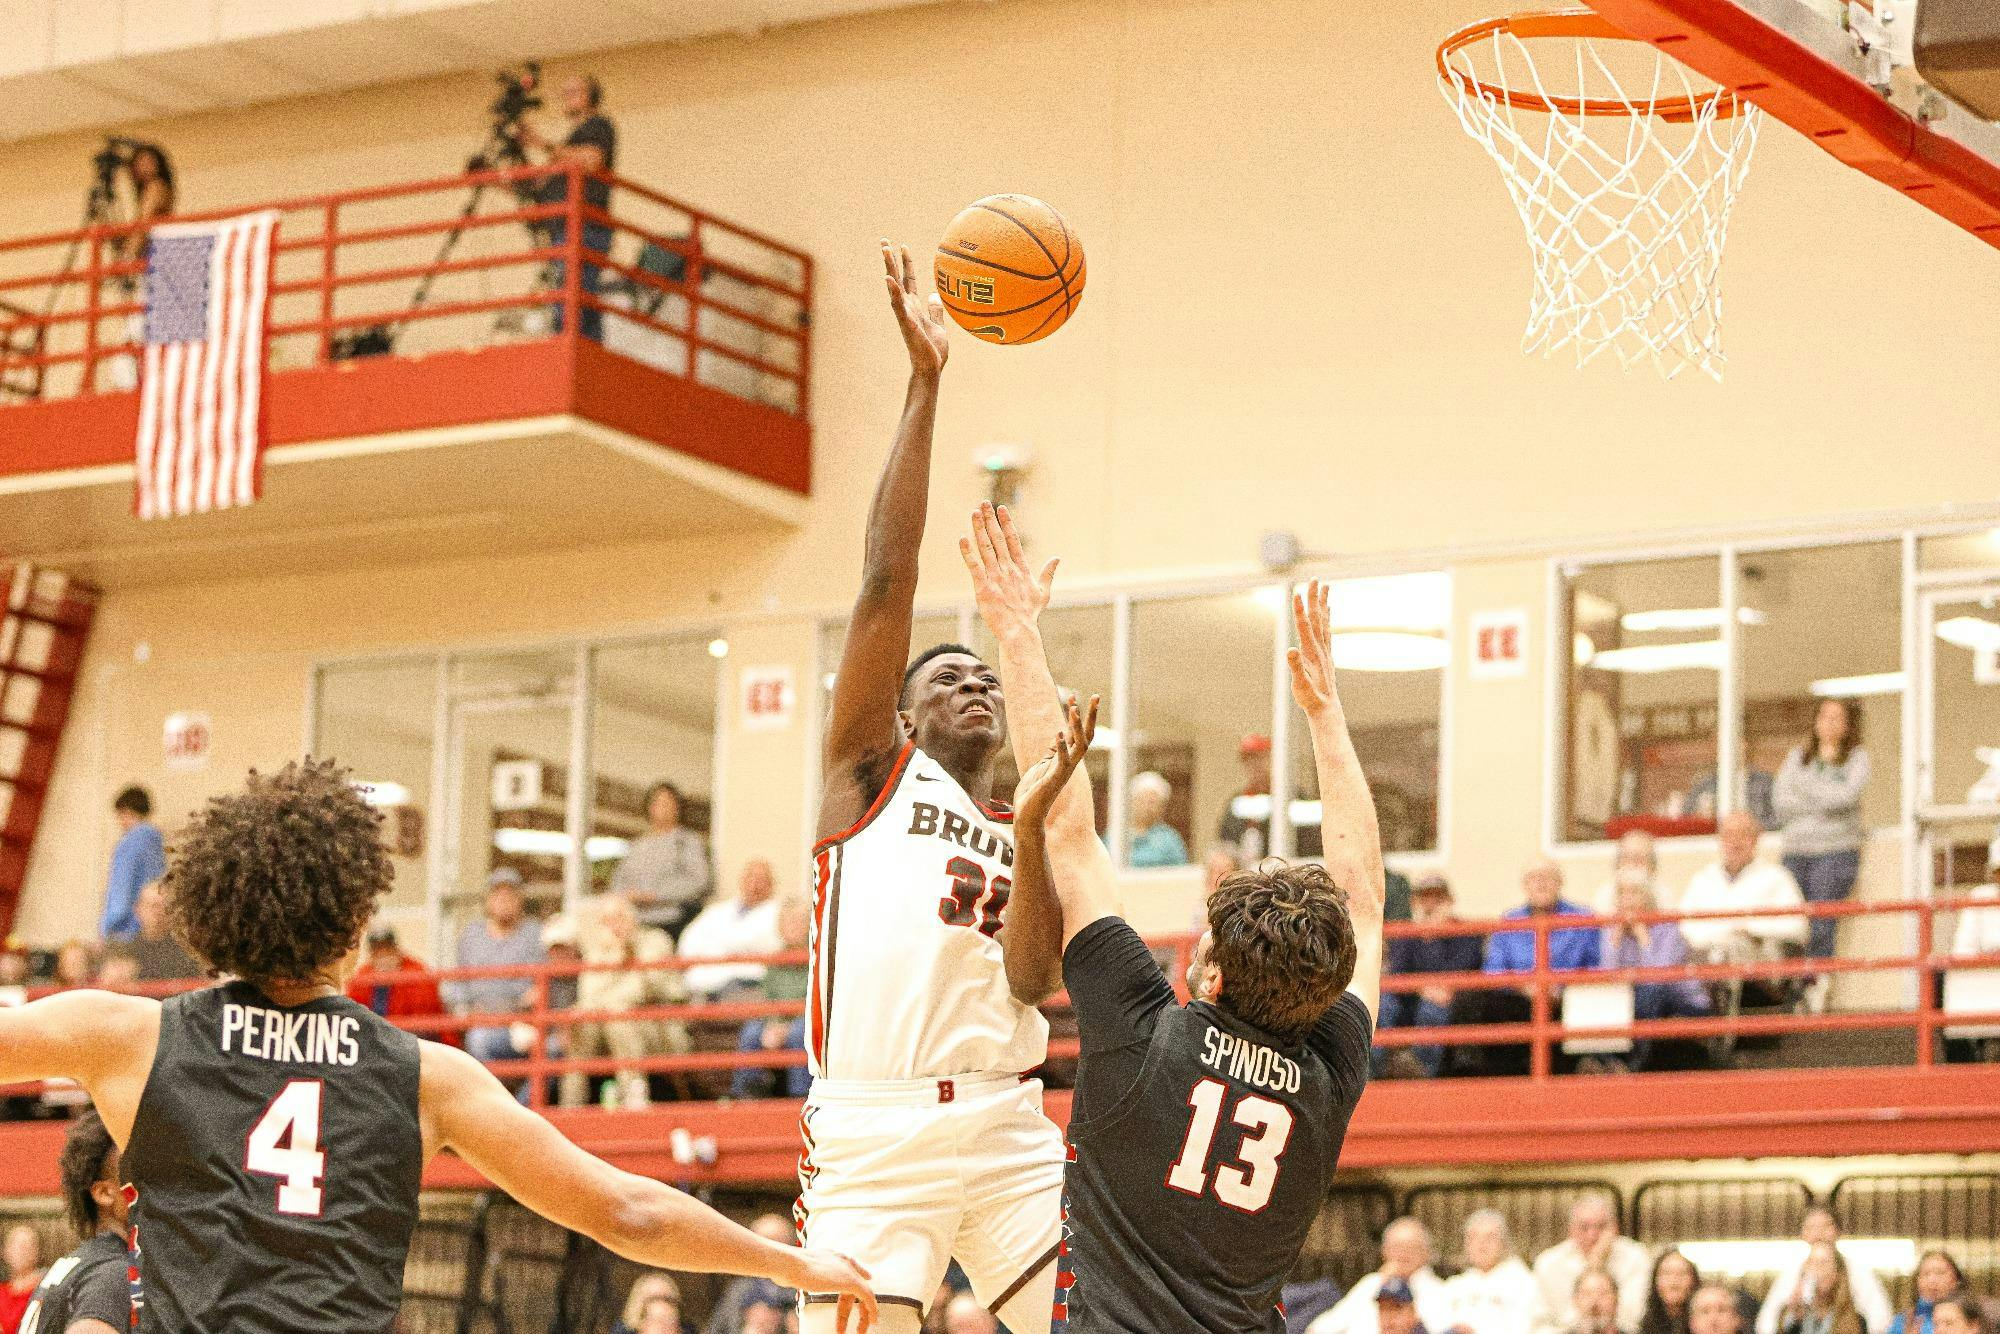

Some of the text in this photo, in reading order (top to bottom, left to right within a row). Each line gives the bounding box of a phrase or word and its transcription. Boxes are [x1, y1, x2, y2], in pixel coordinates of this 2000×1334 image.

[221, 1003, 360, 1066] PERKINS
[1200, 1025, 1301, 1094] SPINOSO
[937, 1079, 954, 1104] B
[243, 1077, 329, 1219] 4
[1164, 1076, 1297, 1215] 13
